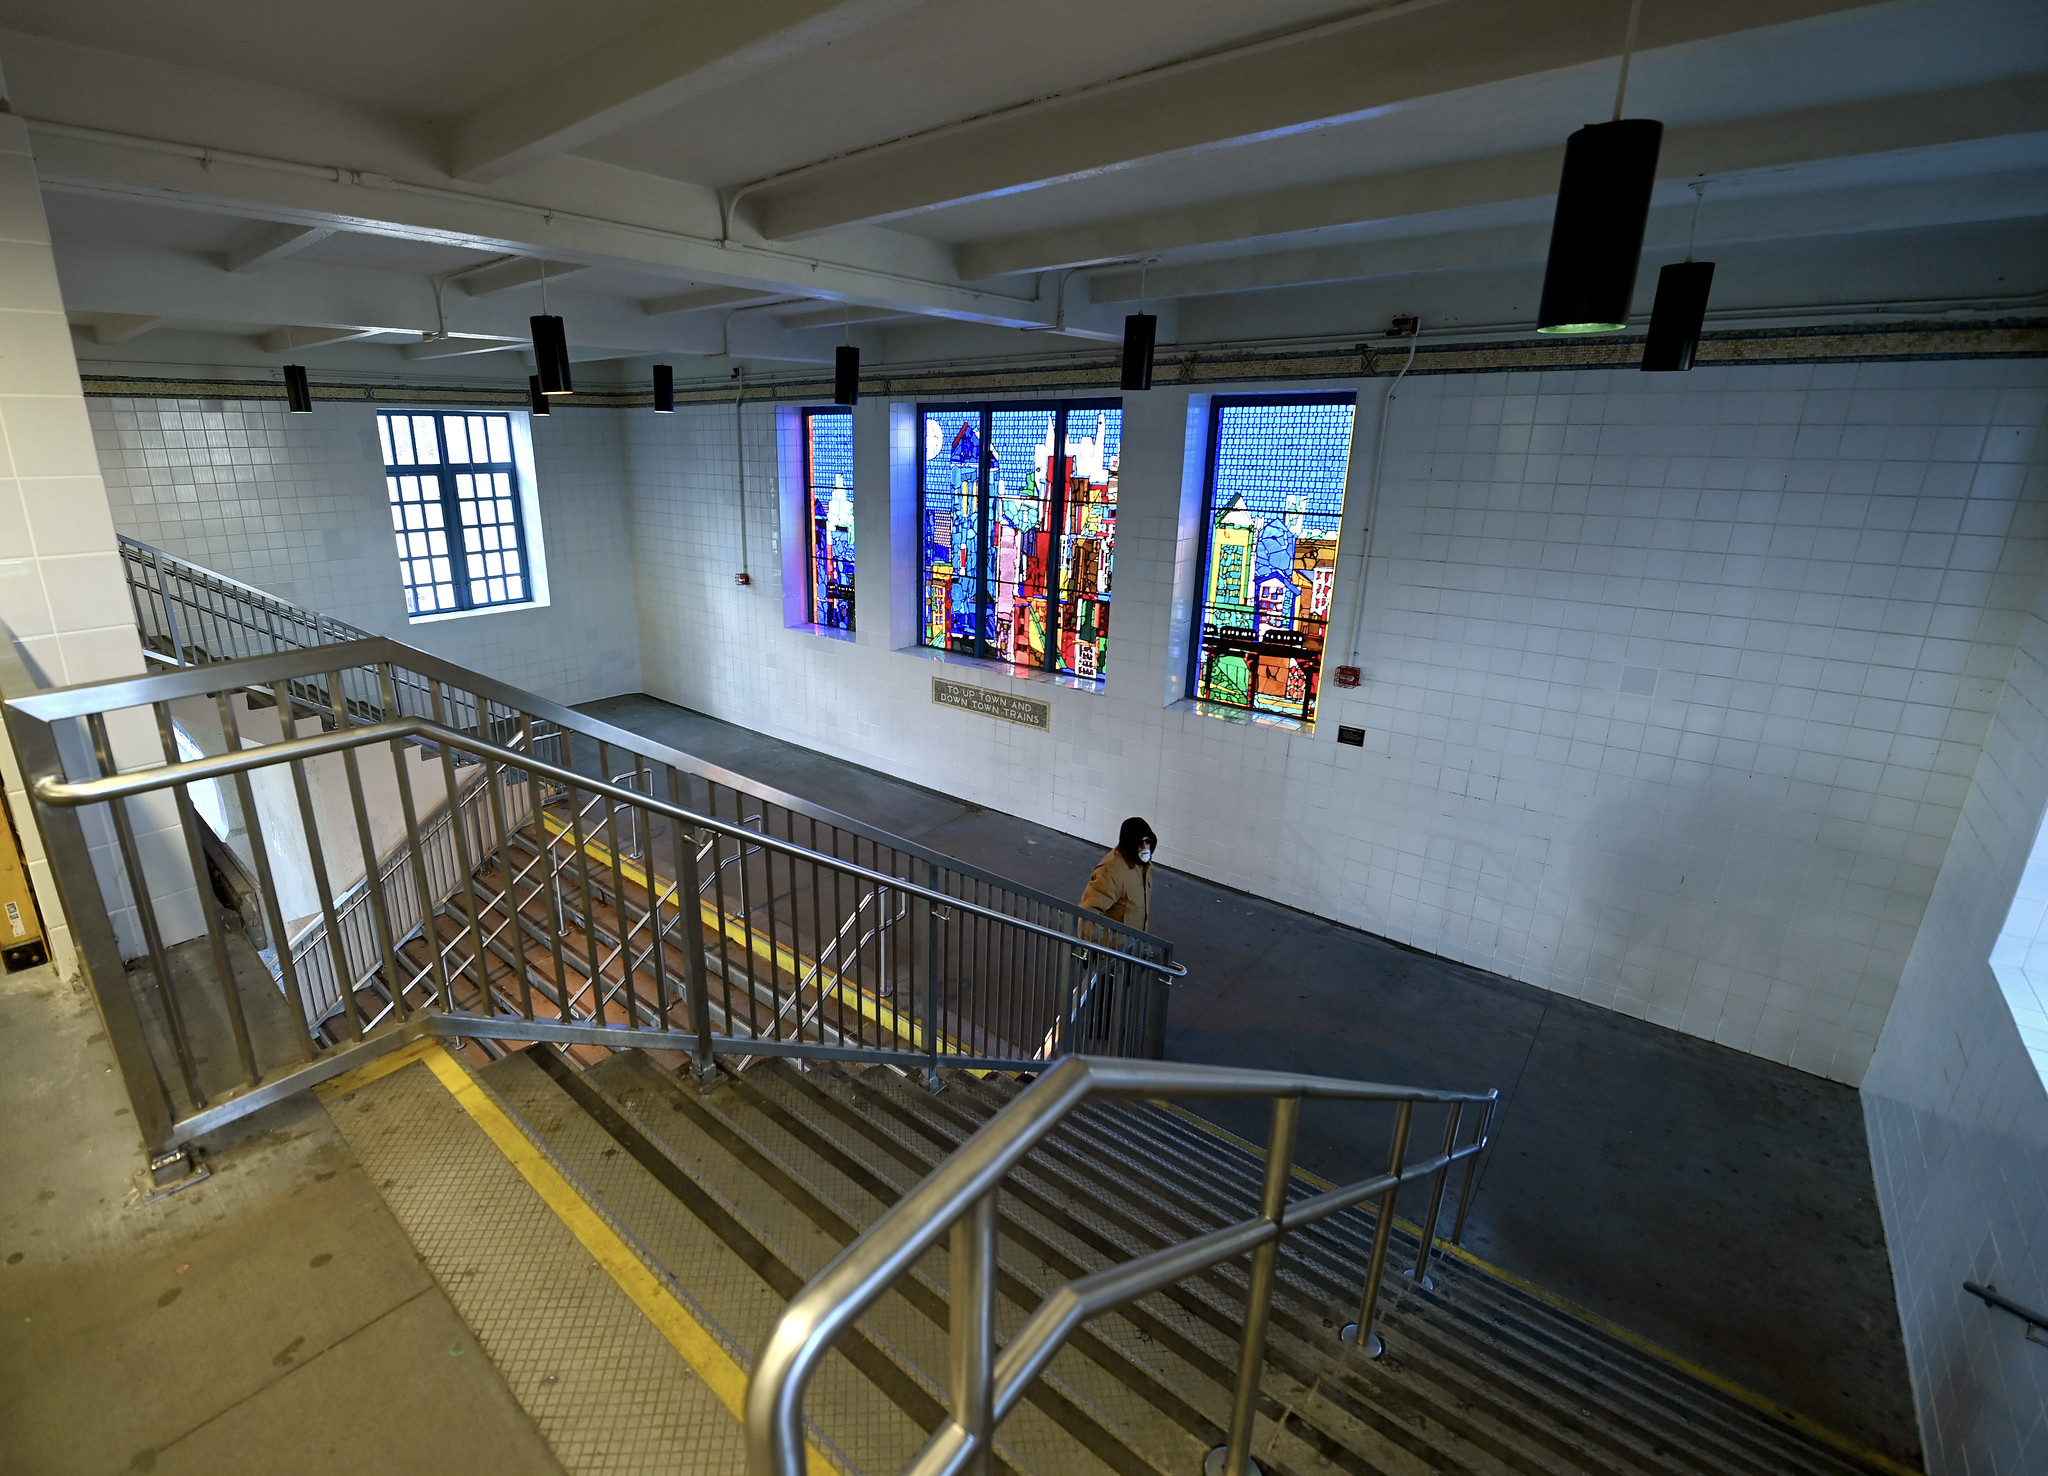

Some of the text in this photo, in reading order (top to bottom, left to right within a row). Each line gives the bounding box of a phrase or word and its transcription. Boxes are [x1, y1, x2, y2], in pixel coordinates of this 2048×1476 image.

[940, 693, 1039, 724] DOWN TOWN TRAINS
[947, 685, 1032, 712] TO UP TOWN AND
